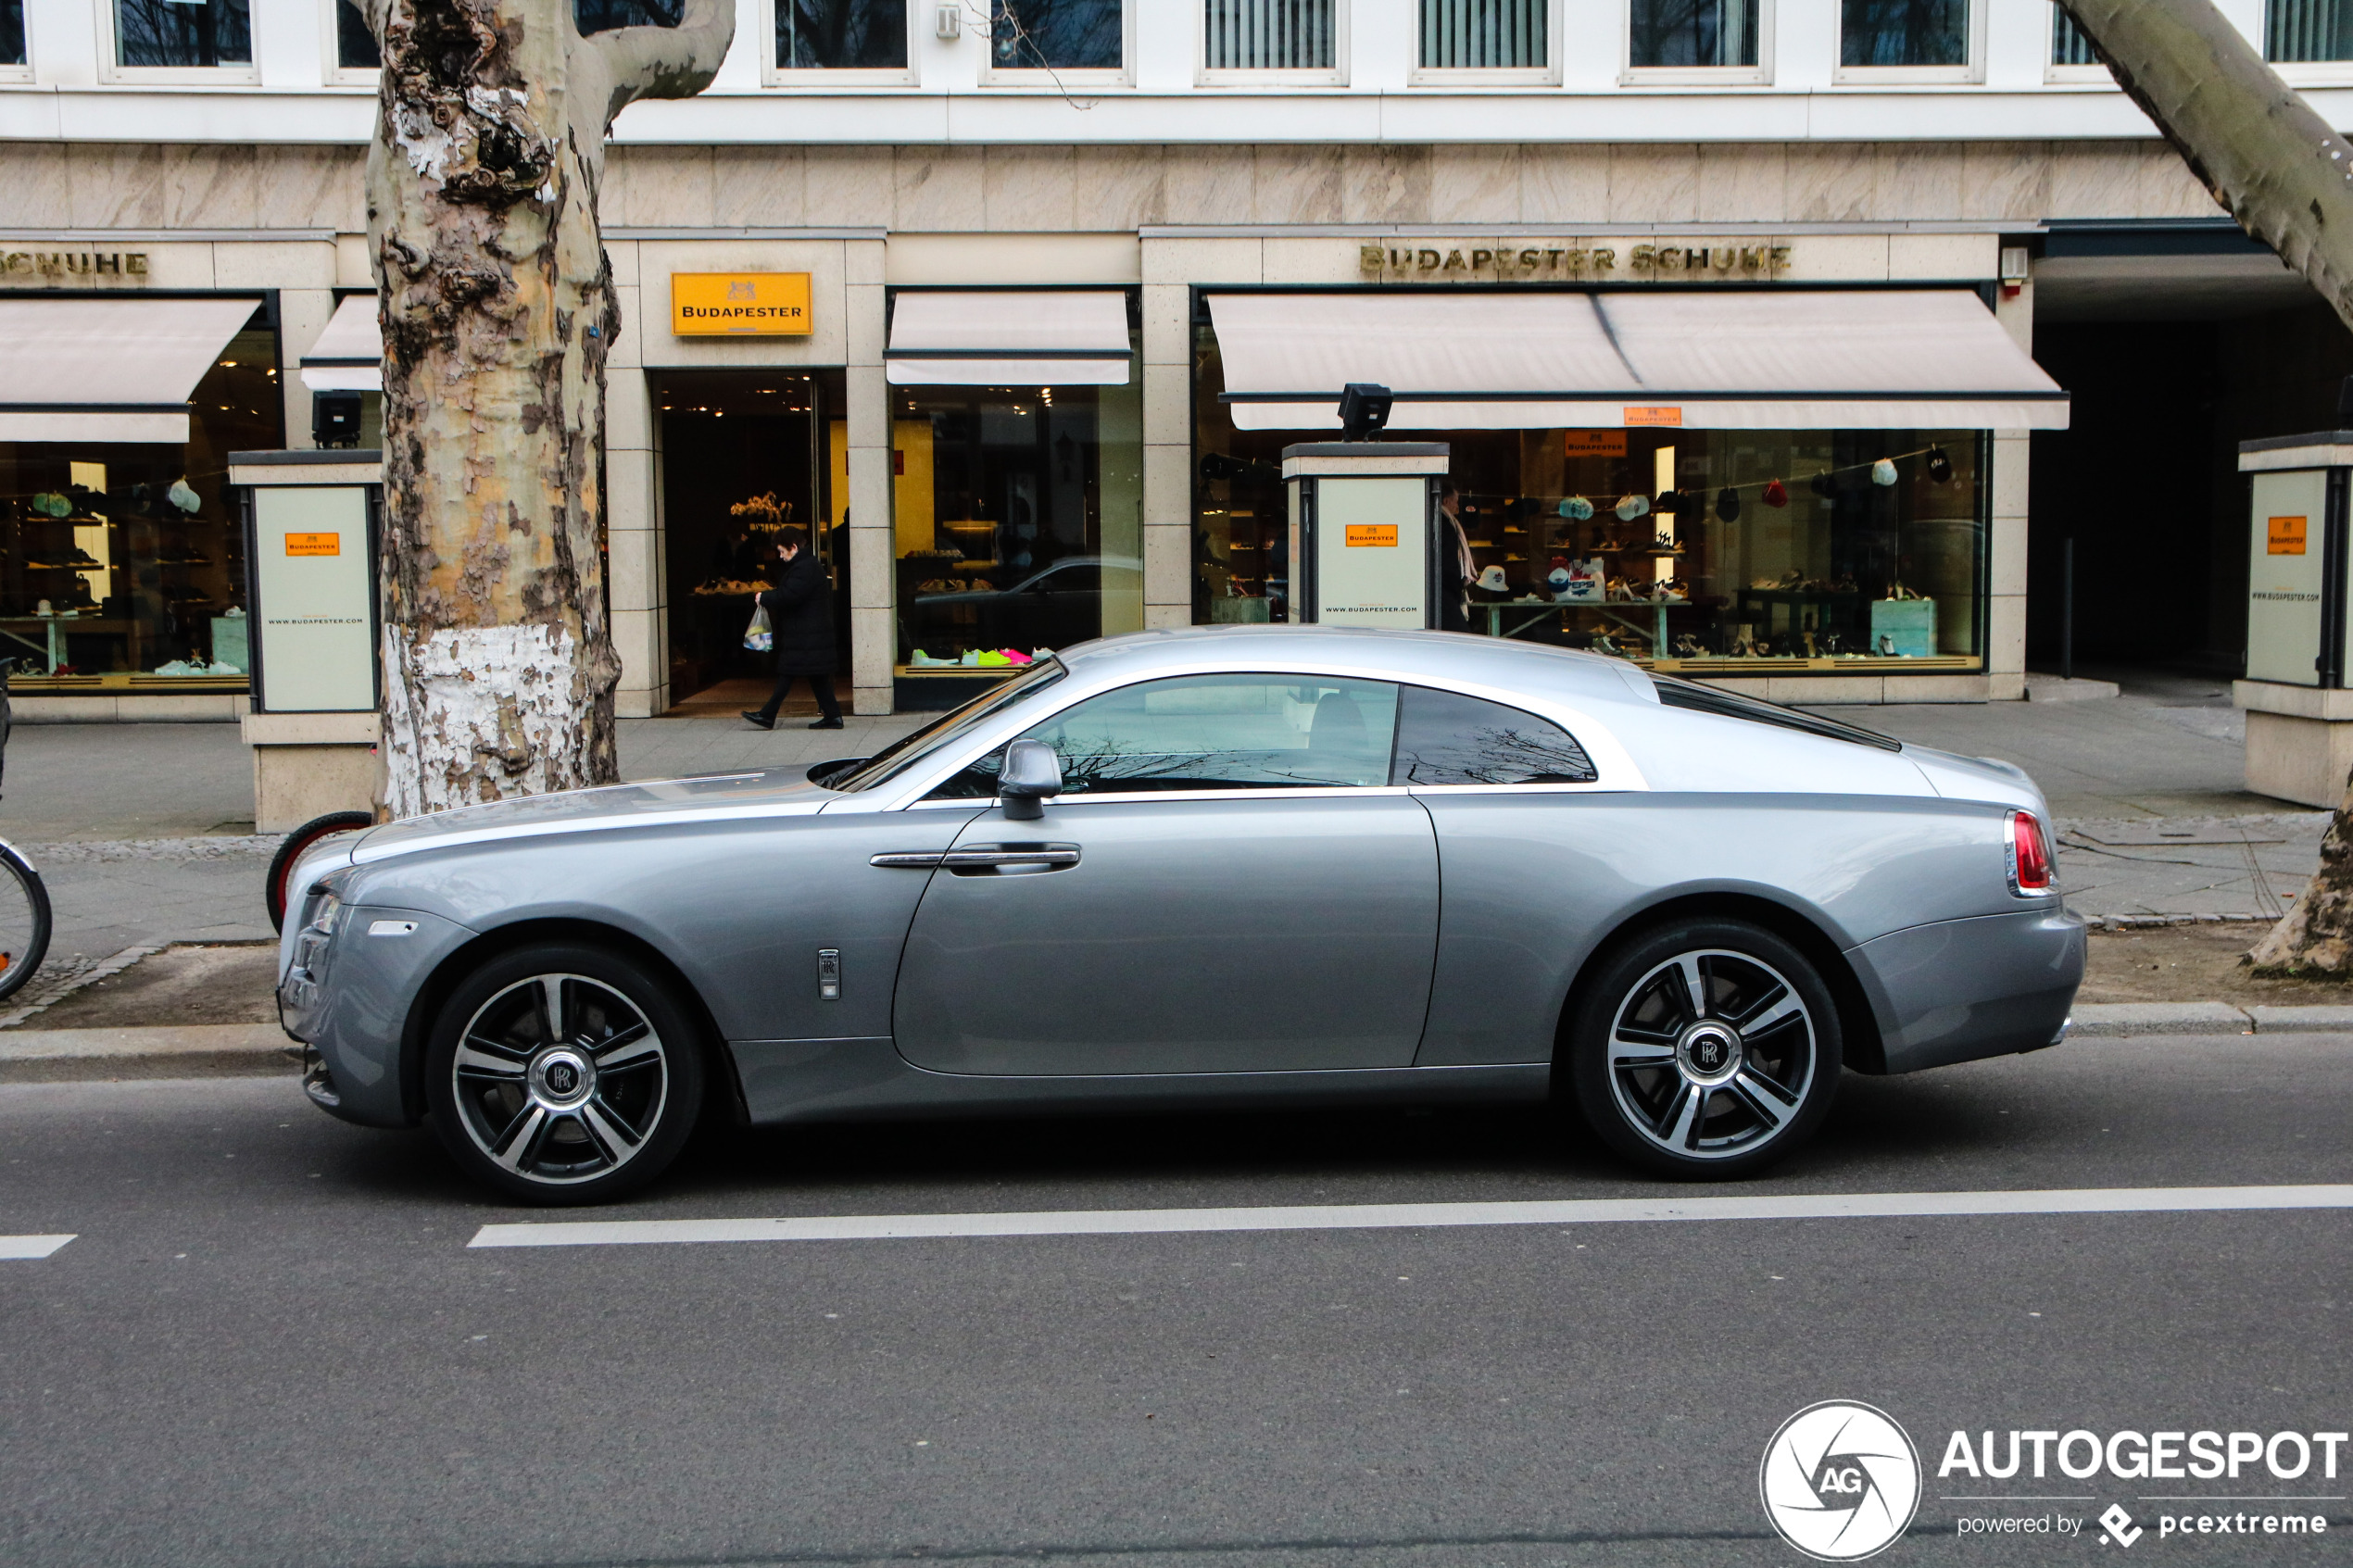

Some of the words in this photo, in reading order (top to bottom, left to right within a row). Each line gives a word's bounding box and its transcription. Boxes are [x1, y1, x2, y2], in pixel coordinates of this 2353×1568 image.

[0, 250, 148, 275] CHUHE
[1359, 245, 1616, 271] BUDAPESTER
[1630, 245, 1792, 270] SCHUHE
[682, 307, 801, 318] BUDAPESTER
[2270, 536, 2304, 545] BUDAPESTER
